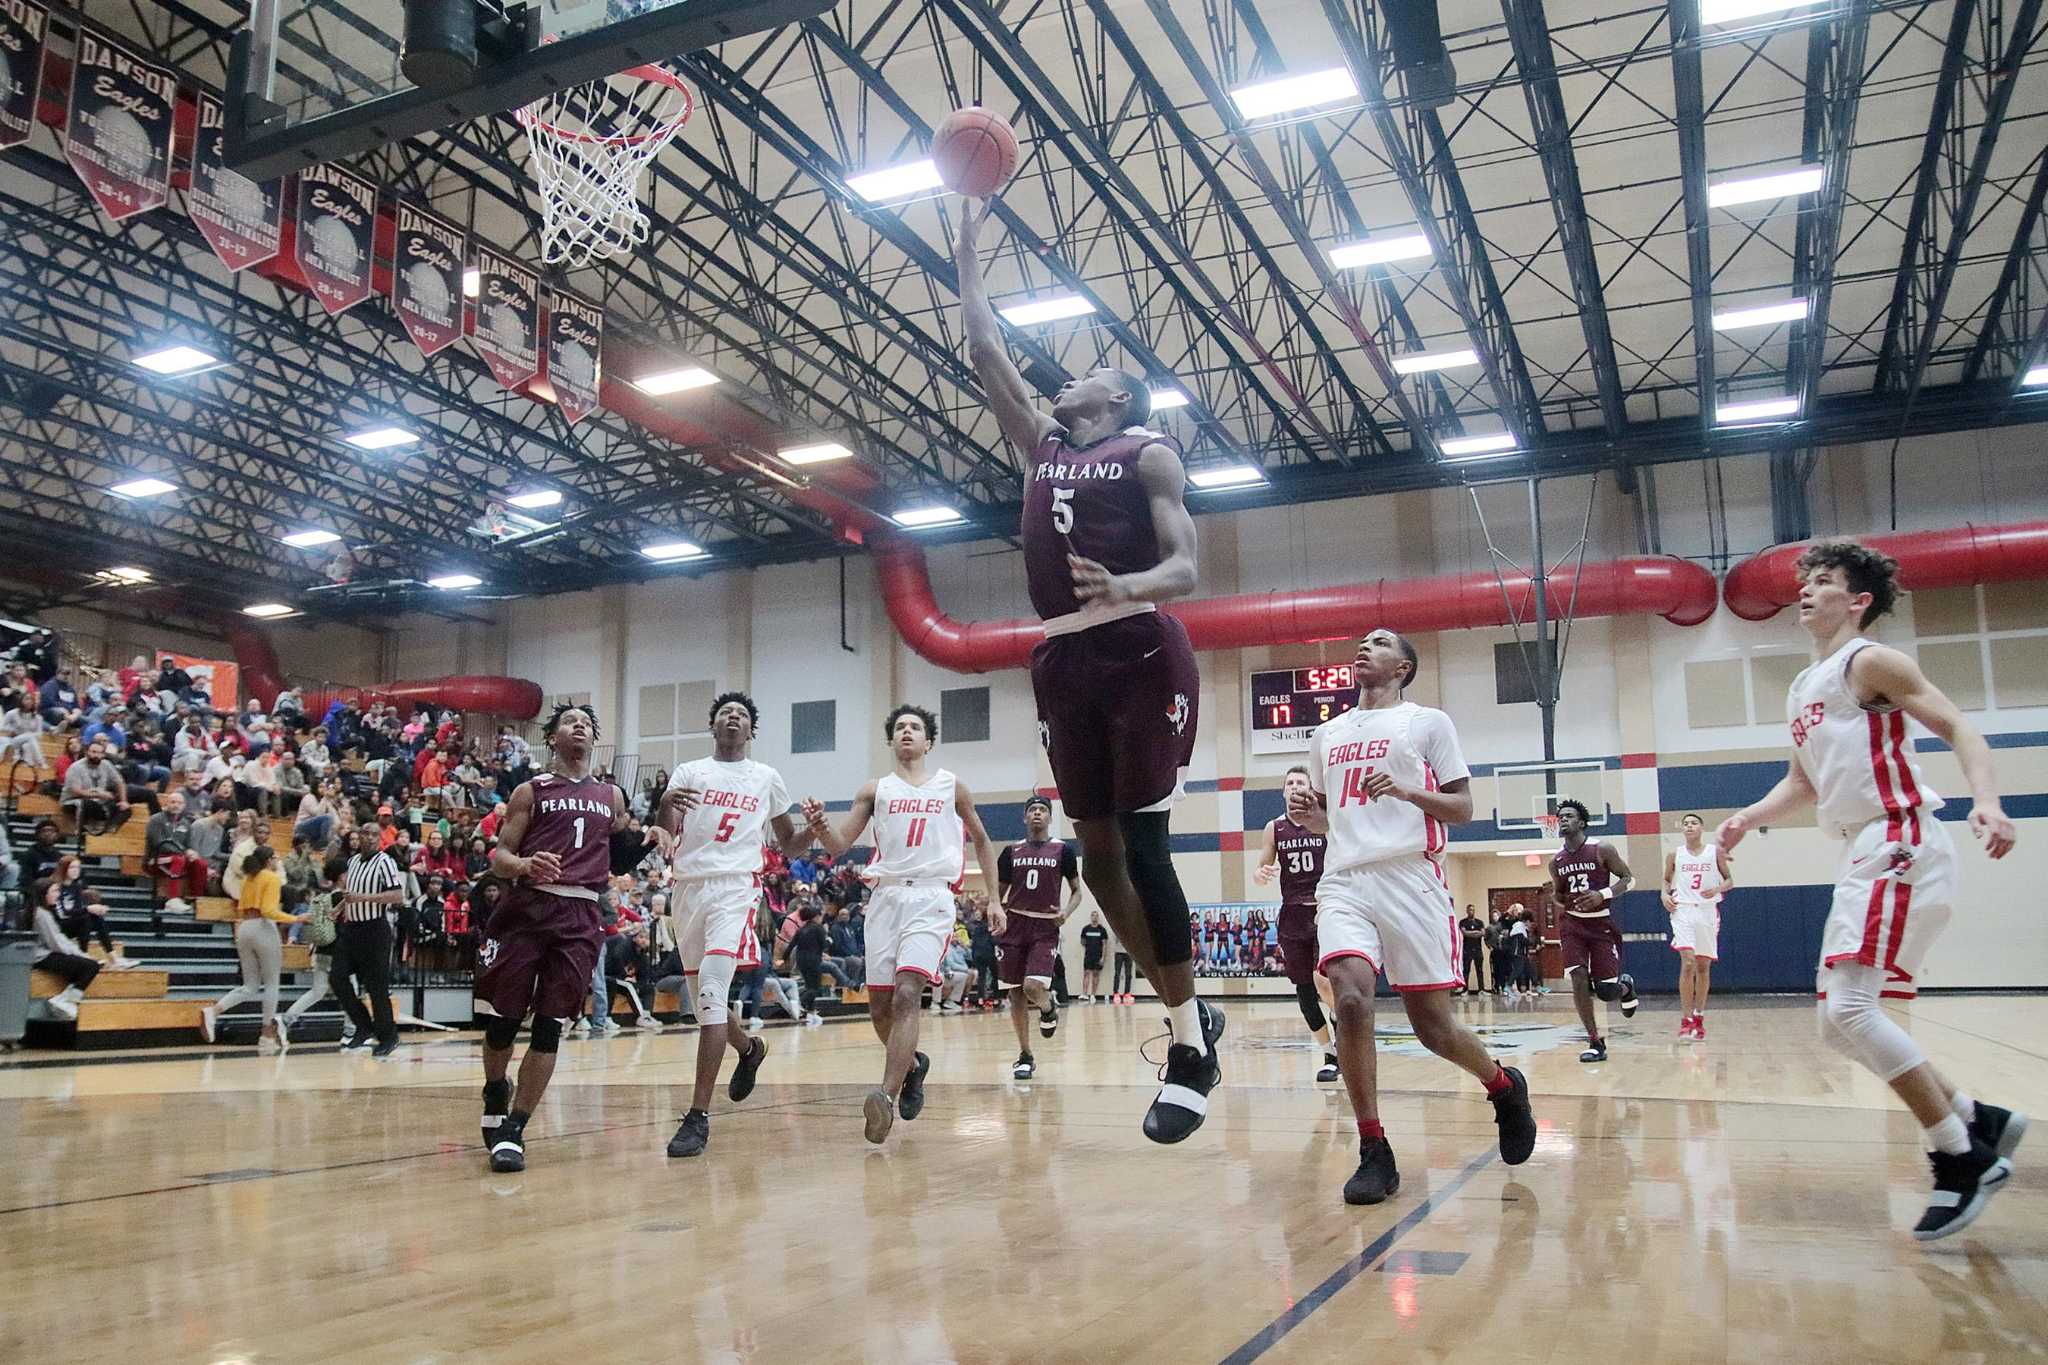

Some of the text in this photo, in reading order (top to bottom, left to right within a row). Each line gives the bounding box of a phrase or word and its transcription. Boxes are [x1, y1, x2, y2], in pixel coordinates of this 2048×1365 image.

[81, 37, 177, 108] DAWSON
[94, 75, 160, 120] Eagles
[301, 163, 374, 215] DAWSON
[310, 189, 362, 225] Eagles
[400, 207, 462, 262] DAWSON
[408, 238, 452, 271] Eagles
[480, 253, 536, 301] DAWSON
[488, 280, 528, 312] Eagles
[558, 318, 598, 346] Eagles
[1052, 487, 1075, 535] 5
[1308, 667, 1351, 690] 5:29
[1259, 694, 1335, 705] EAGLES PERIOD
[1272, 704, 1330, 725] 17 2
[1327, 739, 1391, 768] EAGLES
[703, 789, 759, 813] EAGLES
[1339, 766, 1375, 808] 14
[541, 798, 612, 818] PEARLAND
[888, 799, 945, 817] EAGLES
[573, 817, 585, 849] 1
[714, 813, 740, 843] 5
[906, 818, 927, 847] 11
[1278, 838, 1323, 850] PEARLAND
[1013, 857, 1057, 868] PEARLAND
[1287, 851, 1314, 873] 30
[1558, 862, 1596, 876] PEARLAND
[1681, 863, 1711, 872] EAGLES
[1026, 869, 1039, 890] 0
[1568, 873, 1590, 893] 23
[1691, 874, 1702, 889] 3
